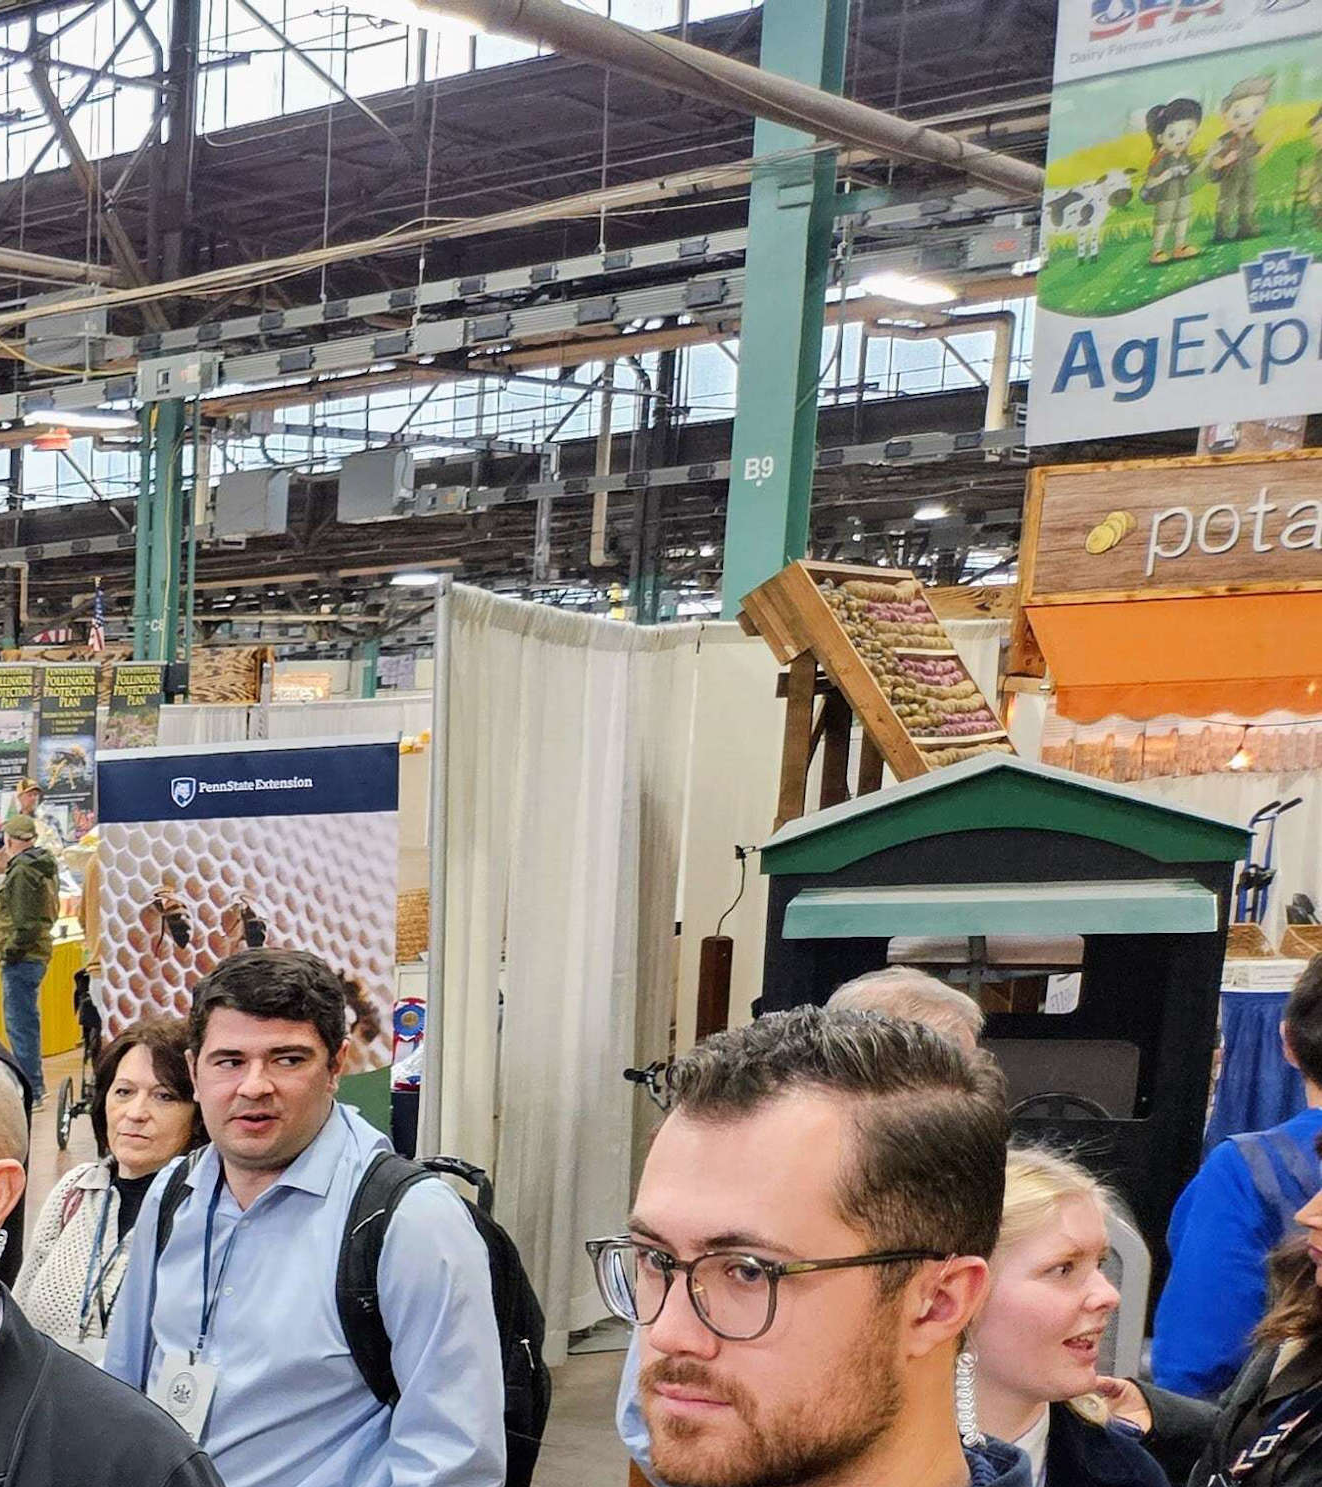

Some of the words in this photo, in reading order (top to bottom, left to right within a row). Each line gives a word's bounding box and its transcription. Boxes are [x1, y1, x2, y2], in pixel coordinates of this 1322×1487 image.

[1069, 47, 1104, 65] Dairy
[1107, 38, 1163, 55] Farmers
[1166, 32, 1183, 44] of
[1184, 22, 1245, 43] America
[1262, 258, 1289, 275] PA
[1251, 271, 1299, 290] FARM
[1247, 285, 1299, 304] SHOW
[1051, 312, 1322, 403] AgExp
[744, 455, 774, 480] B9
[1146, 486, 1322, 577] pota
[44, 675, 95, 686] POLLINATOR
[43, 686, 95, 697] PROTECTION
[59, 697, 81, 708] PLAN
[198, 780, 254, 794] PennState
[255, 776, 313, 791] Extension
